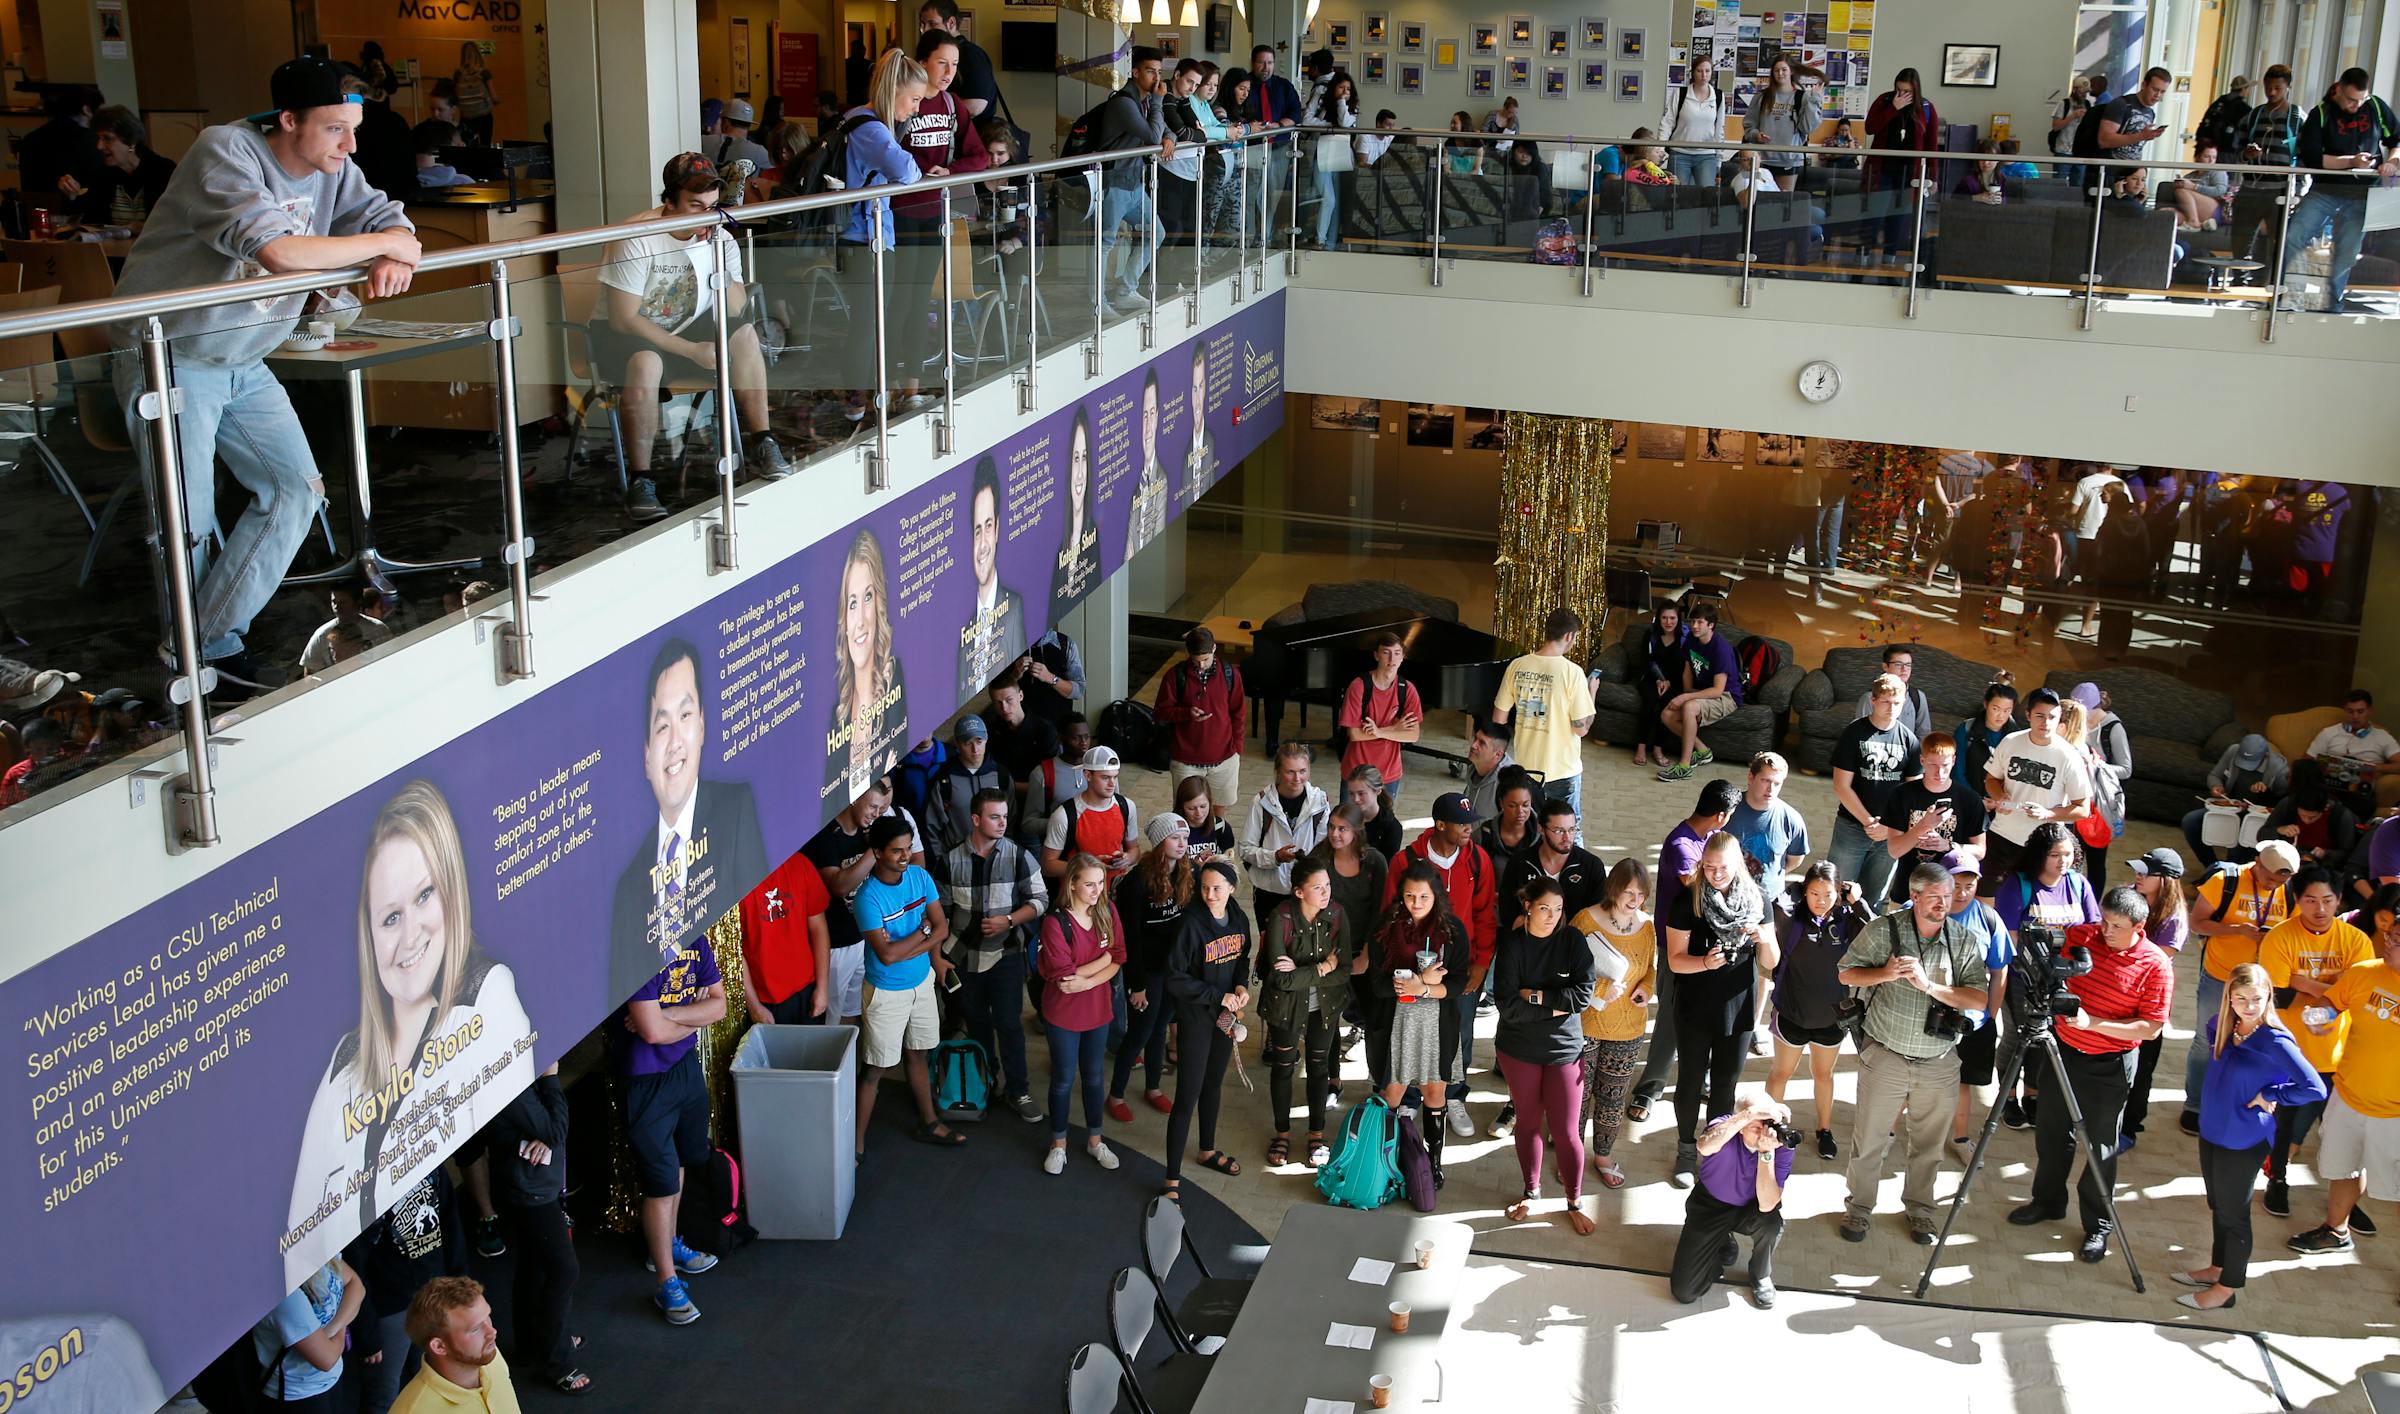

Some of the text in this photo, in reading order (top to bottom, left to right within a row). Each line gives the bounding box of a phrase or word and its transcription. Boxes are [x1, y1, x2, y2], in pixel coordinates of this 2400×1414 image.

[397, 0, 521, 21] MavCARD
[719, 600, 804, 659] a student senator has been
[736, 605, 765, 631] privilege
[767, 598, 773, 611] to
[775, 589, 790, 606] serve
[792, 584, 800, 595] as
[720, 621, 801, 680] a tremendously rewarding
[774, 649, 789, 666] been
[722, 653, 806, 721] inspired by every Maverick
[722, 678, 801, 742] to reach for excellence in
[827, 684, 901, 756] Haley Severson
[723, 740, 736, 762] and
[738, 732, 749, 752] out
[751, 724, 758, 742] of
[760, 719, 769, 736] the
[821, 778, 840, 798] Gamma
[891, 716, 907, 738] Council
[530, 790, 536, 803] a
[540, 768, 570, 796] leader
[573, 749, 601, 775] means
[494, 780, 590, 851] stepping out of your
[495, 802, 592, 876] comfort zone for the
[497, 854, 550, 900] betterment
[552, 841, 561, 862] of
[650, 827, 708, 895] Tien Bui
[647, 865, 714, 926] Information Systems
[647, 921, 663, 944] CSU
[687, 879, 716, 911] President
[695, 903, 708, 923] MN
[123, 967, 144, 987] as
[150, 953, 162, 972] a
[168, 922, 205, 959] CSU
[210, 876, 280, 937] Technical
[27, 914, 282, 1079] Services Lead has given me a
[32, 943, 286, 1120] positive leadership experience
[35, 971, 290, 1146] and an extensive appreciation
[38, 1025, 252, 1180] for this University and its
[342, 1013, 484, 1142] Kayla Stone
[389, 1081, 450, 1139] Psychology
[279, 1194, 342, 1255] Mavericks
[344, 1165, 375, 1202] After
[378, 1138, 406, 1171] Dark
[408, 1113, 440, 1148] Chair,
[442, 1077, 481, 1118] Student
[482, 1051, 512, 1085] Events
[513, 1030, 539, 1057] Team
[390, 1116, 456, 1186] Baldwin, WI
